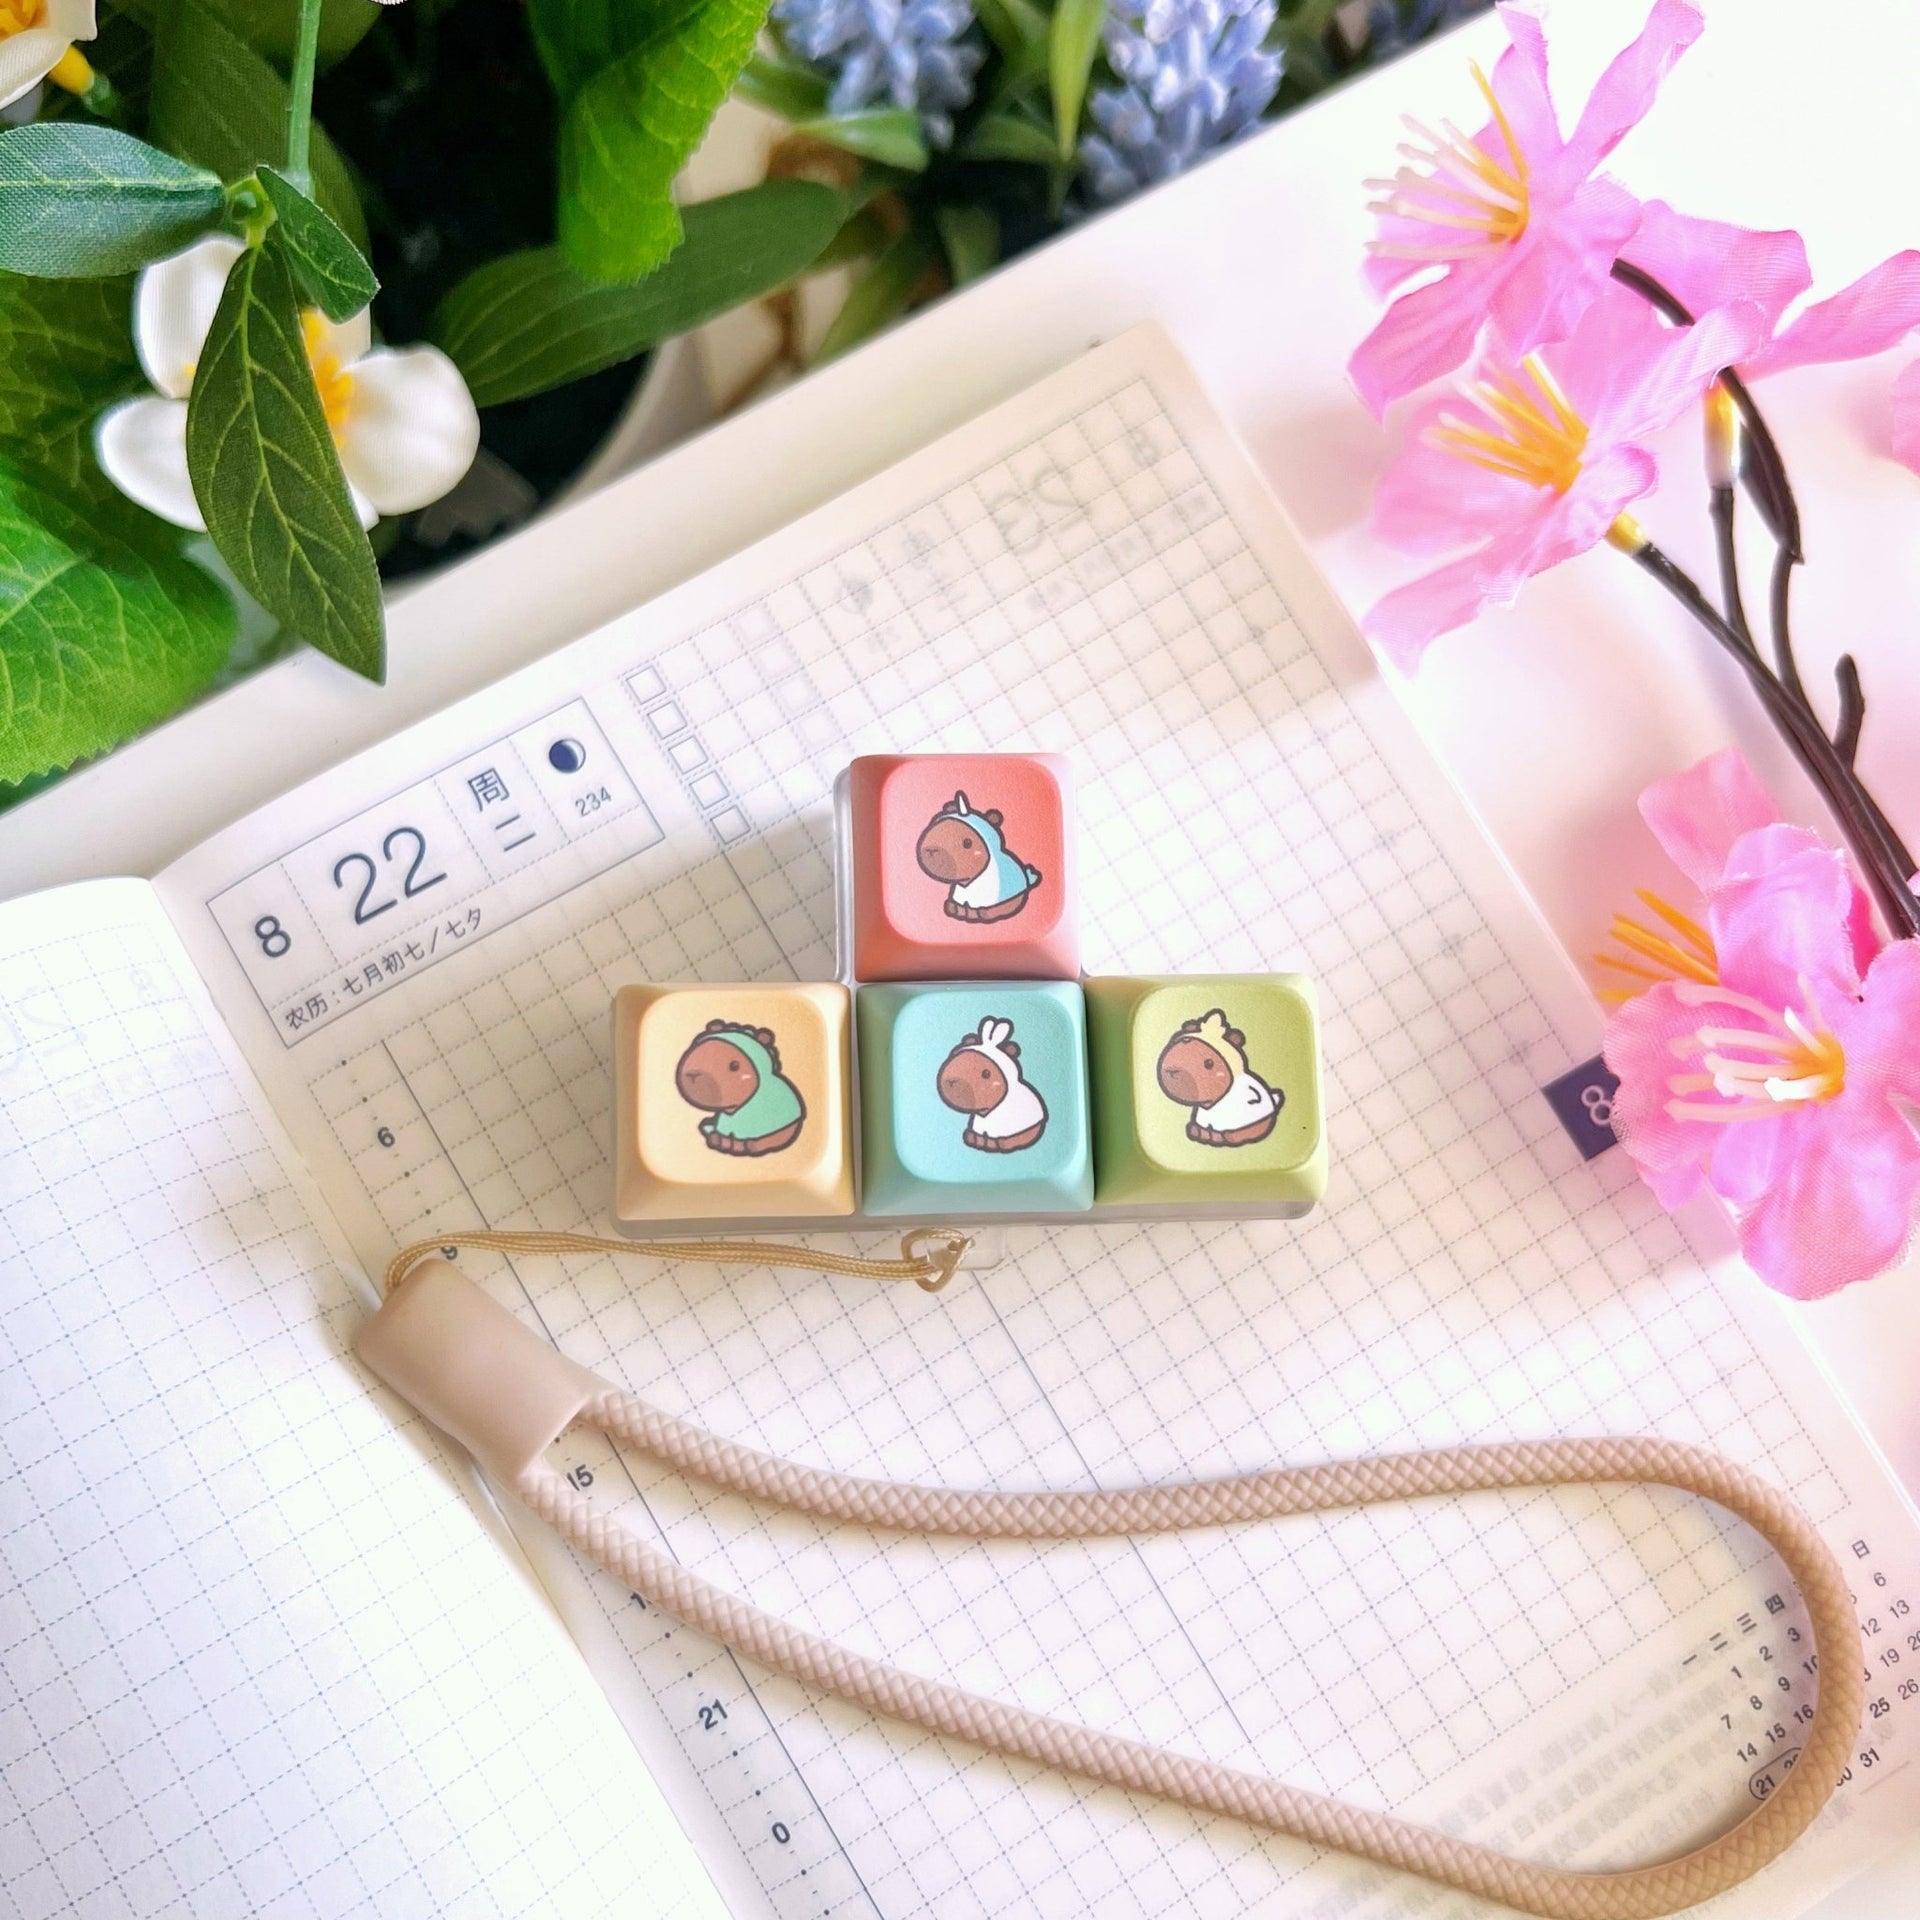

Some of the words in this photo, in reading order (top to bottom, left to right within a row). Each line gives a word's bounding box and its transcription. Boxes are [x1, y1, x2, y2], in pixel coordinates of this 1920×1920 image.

[467, 767, 537, 853] 周二
[574, 786, 612, 817] 234
[253, 915, 292, 959] 8
[332, 826, 448, 926] 22
[377, 1126, 396, 1148] 6
[1580, 1084, 1612, 1127] 8
[566, 1464, 594, 1492] 15
[1708, 1632, 1728, 1651] 二
[1736, 1612, 1757, 1634] 三
[1764, 1593, 1785, 1615] 四
[1852, 1540, 1870, 1559] 日
[1731, 1665, 1743, 1679] 1
[1759, 1645, 1774, 1662] 2
[1787, 1627, 1801, 1642] 3
[1873, 1572, 1887, 1588] 6
[1720, 1713, 1733, 1730] 7
[1750, 1695, 1763, 1711] 8
[1777, 1676, 1791, 1692] 9
[1861, 1617, 1882, 1637] 12
[1889, 1599, 1910, 1619] 13
[698, 1698, 727, 1730] 21
[1737, 1742, 1758, 1763] 14
[1765, 1722, 1786, 1743] 15
[1793, 1704, 1814, 1724] 16
[1879, 1648, 1900, 1668] 19
[1755, 1774, 1776, 1795] 21
[1869, 1697, 1890, 1718] 25
[1897, 1679, 1919, 1700] 26
[1859, 1747, 1880, 1768] 31
[771, 1821, 791, 1844] 0
